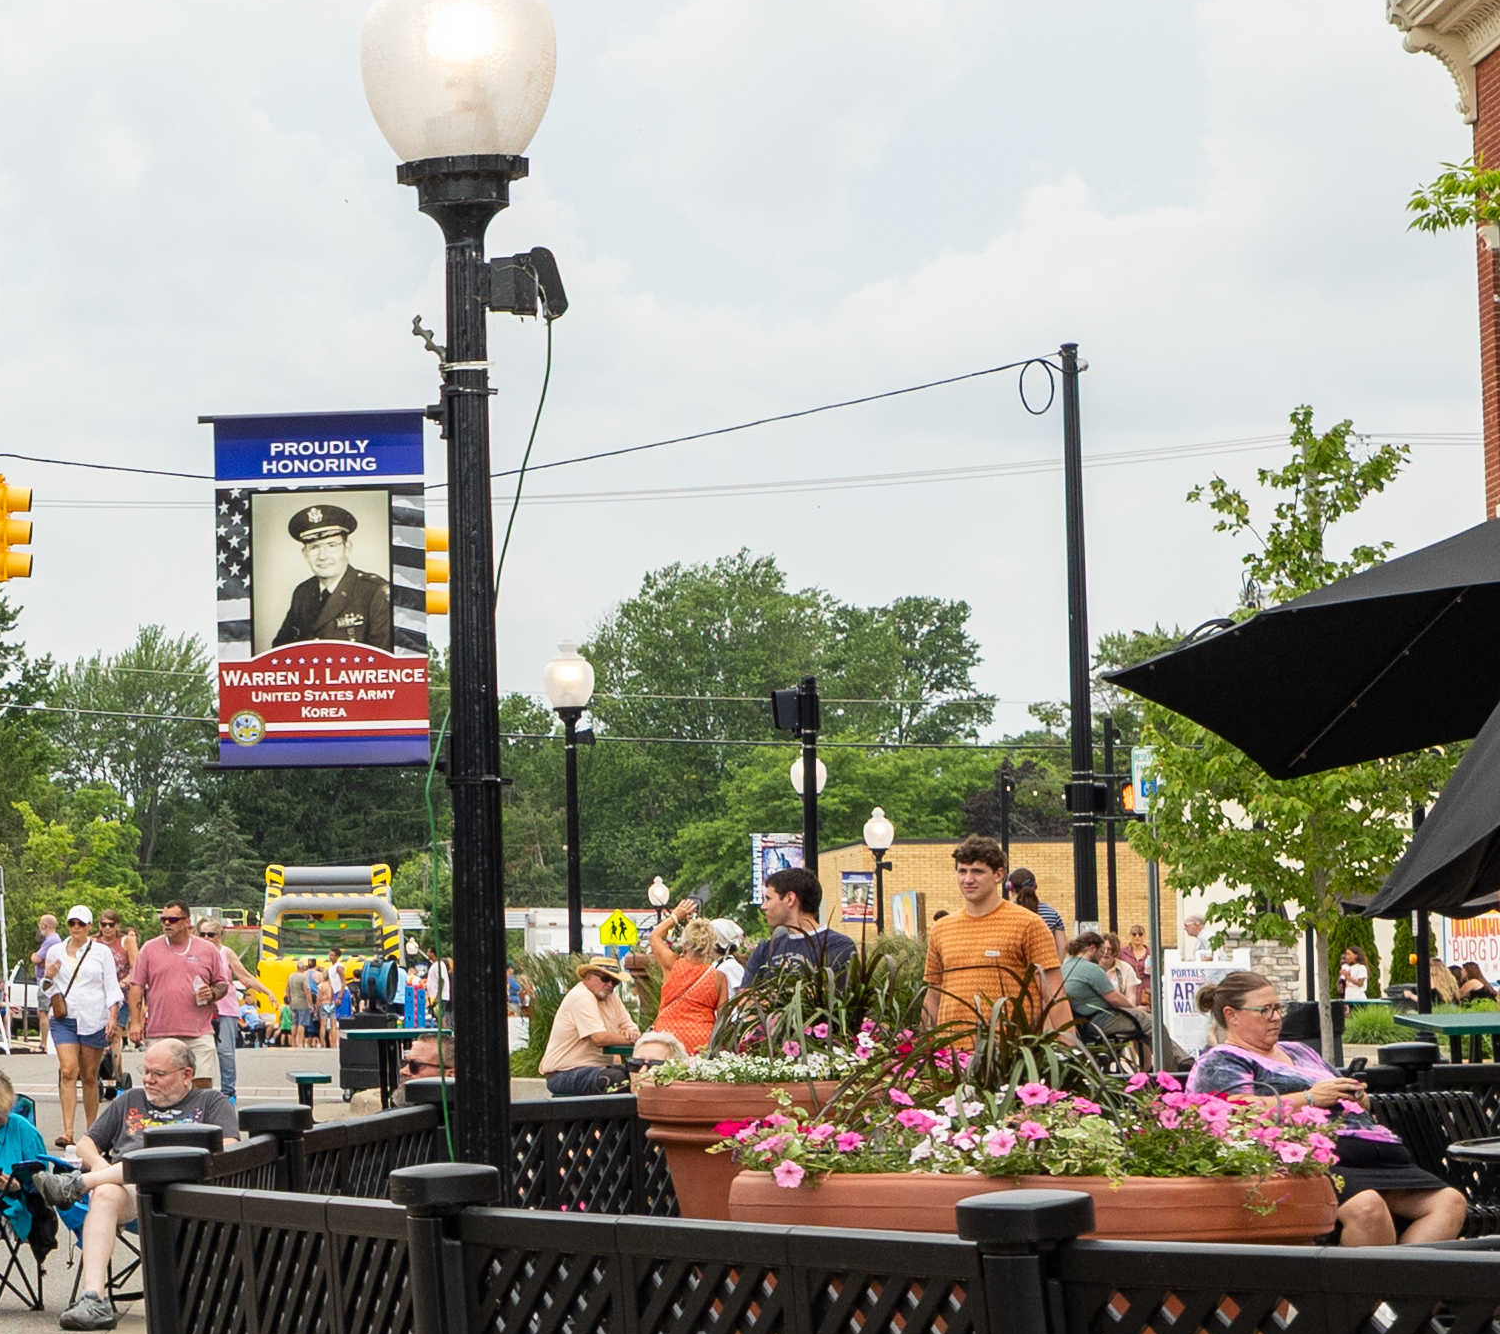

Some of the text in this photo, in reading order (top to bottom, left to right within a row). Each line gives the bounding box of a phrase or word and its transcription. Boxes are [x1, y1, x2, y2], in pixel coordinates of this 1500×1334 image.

[270, 439, 369, 456] PROUDLY
[262, 457, 377, 474] HONORING
[222, 668, 425, 687] WARREN J. LAWRENCE
[251, 689, 396, 702] UNITED STATES ARMY
[301, 706, 347, 718] KOREA
[1490, 938, 1500, 960] D
[1171, 969, 1206, 978] PORTALS
[1173, 982, 1205, 1000] AR
